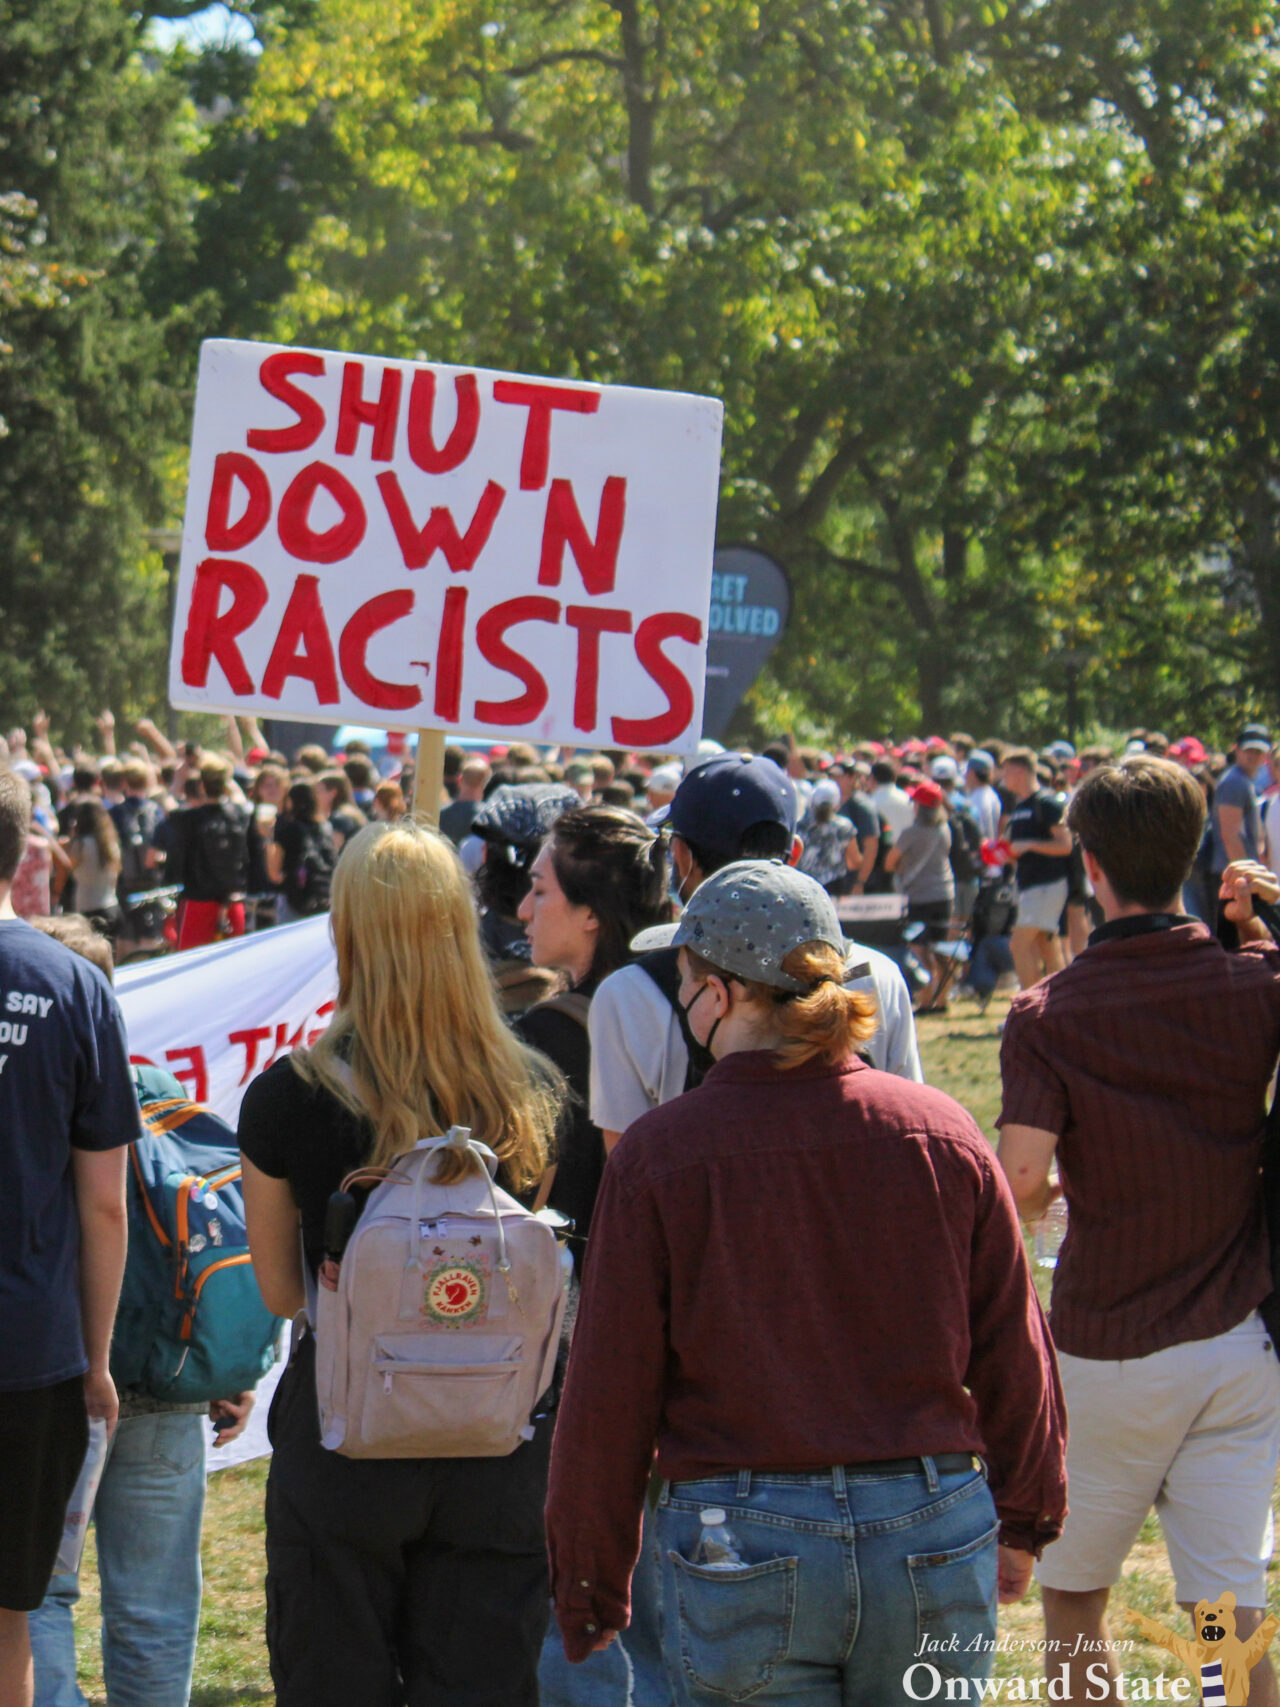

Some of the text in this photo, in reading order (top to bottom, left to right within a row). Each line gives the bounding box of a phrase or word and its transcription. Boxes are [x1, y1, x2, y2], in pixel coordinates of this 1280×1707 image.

[247, 352, 600, 490] SHUT
[206, 452, 626, 595] DOWN
[181, 558, 702, 747] RACISTS
[5, 991, 54, 1018] SAY
